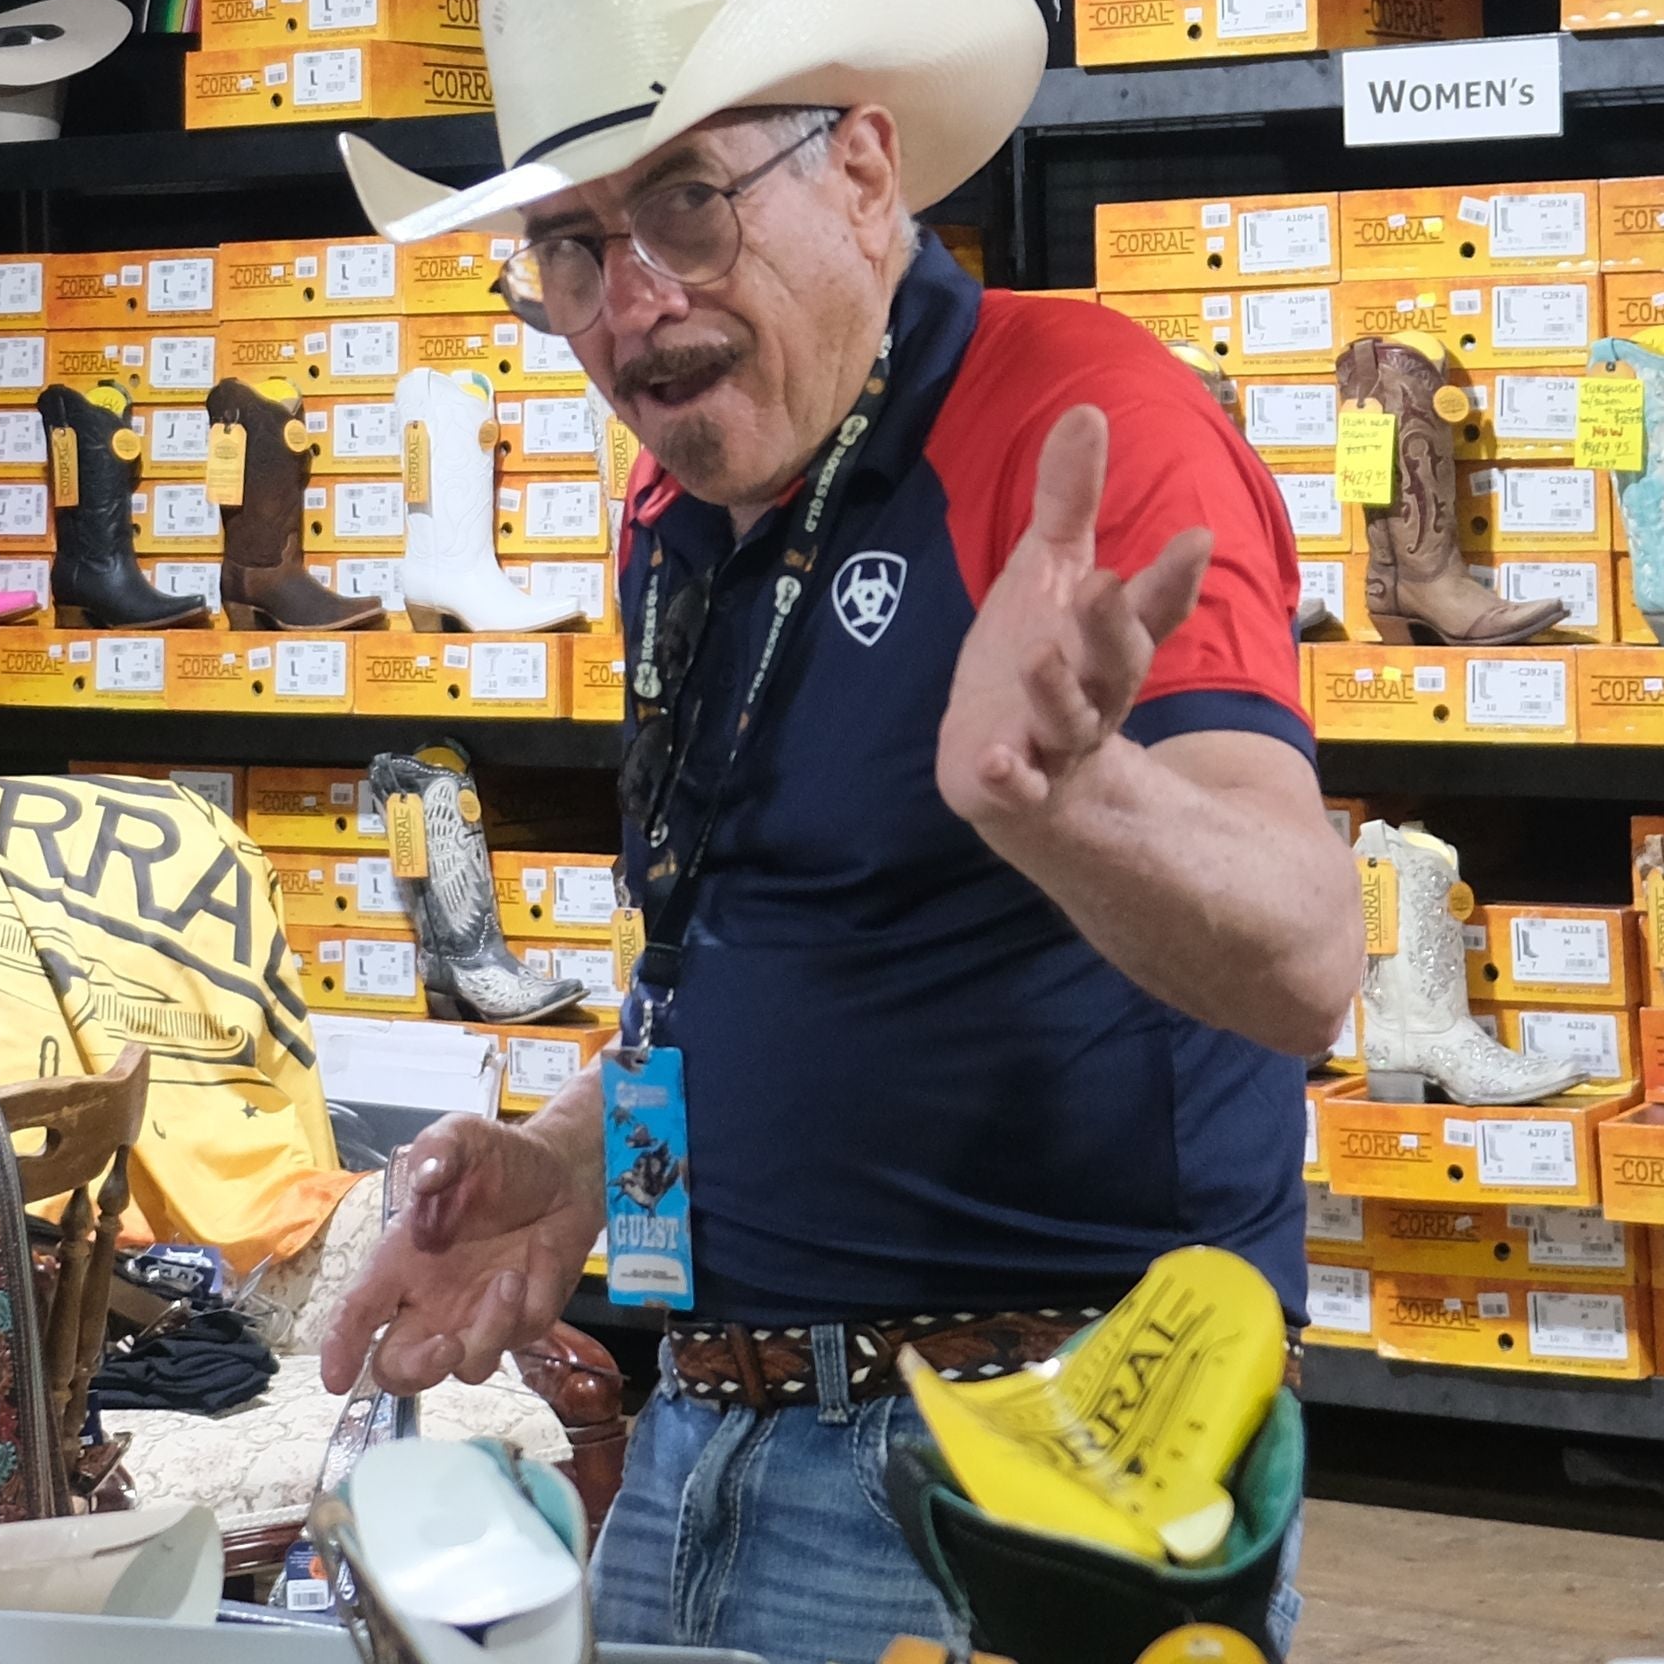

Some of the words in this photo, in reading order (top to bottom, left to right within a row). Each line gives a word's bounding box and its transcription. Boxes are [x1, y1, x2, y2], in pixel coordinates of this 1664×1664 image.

[1095, 4, 1169, 26] CORRAL
[1116, 232, 1190, 253] CORRAL
[1363, 310, 1444, 331] CORRAL
[394, 809, 408, 868] CORRAL
[615, 1215, 679, 1249] GUEST
